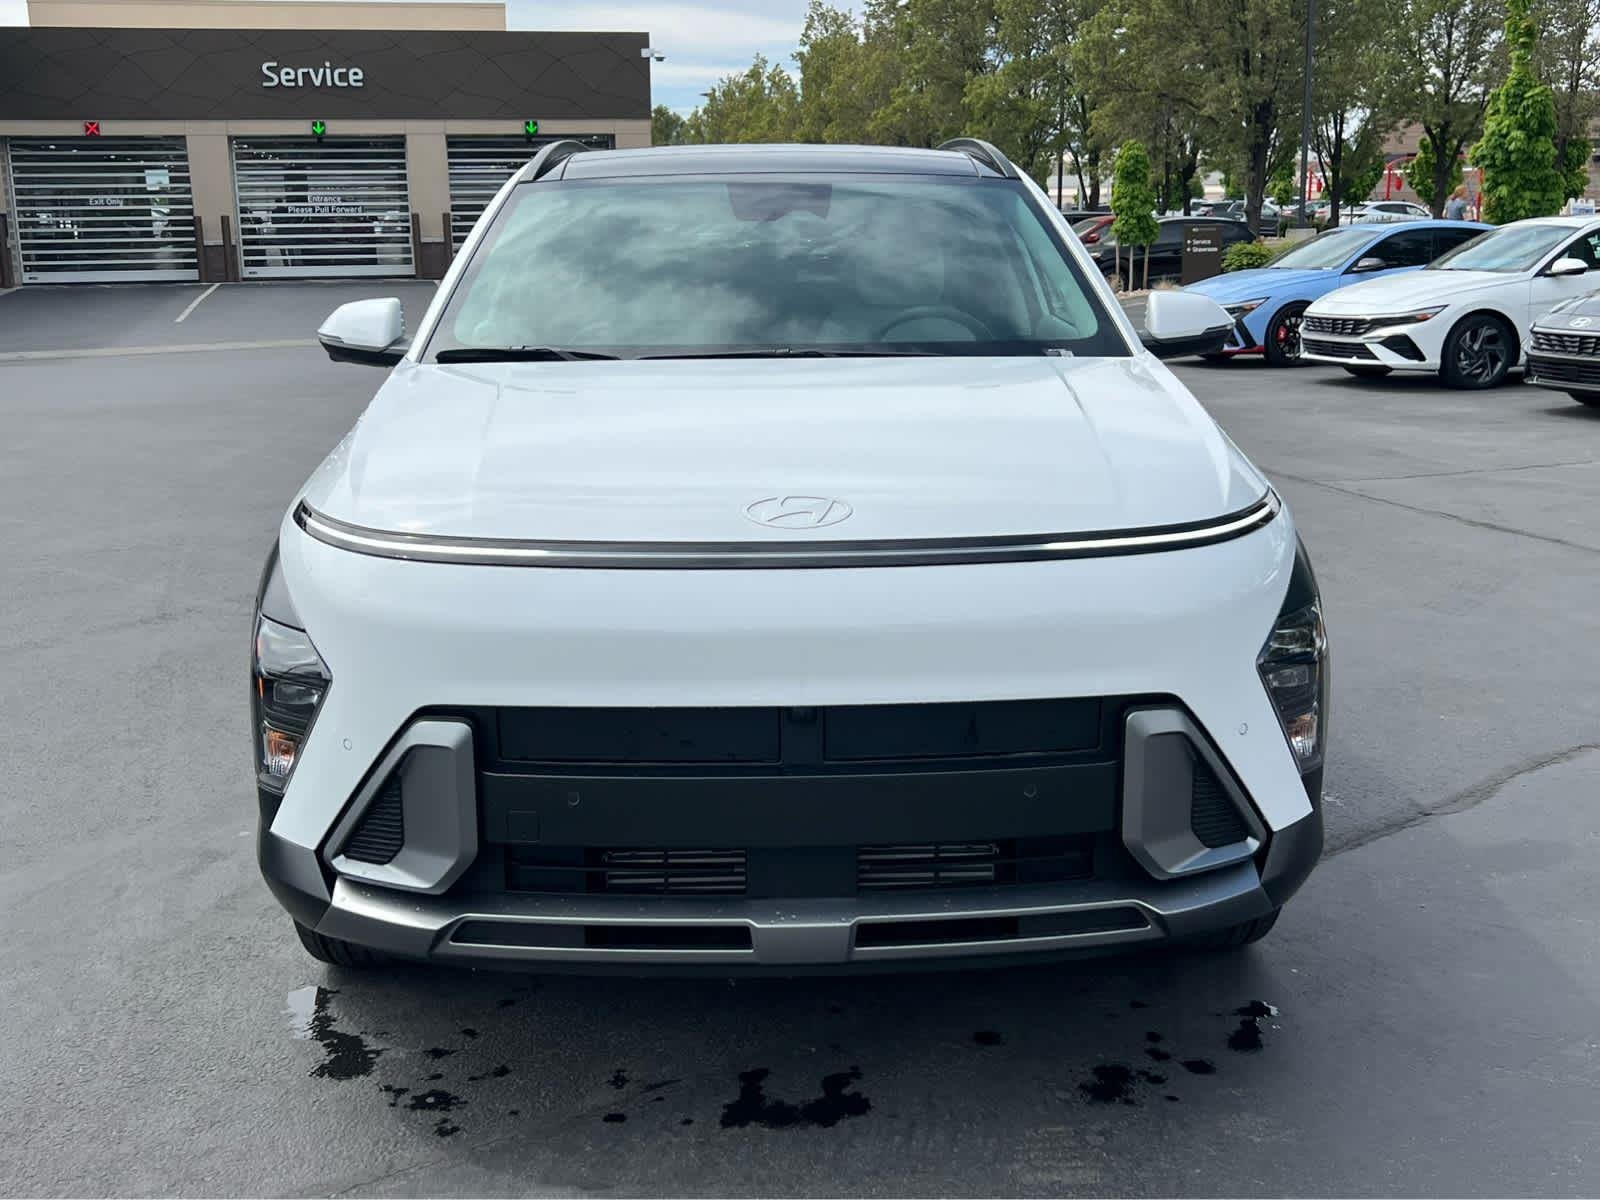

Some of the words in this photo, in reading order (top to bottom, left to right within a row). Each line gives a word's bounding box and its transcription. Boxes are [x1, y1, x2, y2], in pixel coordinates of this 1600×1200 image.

[261, 61, 364, 87] Service
[88, 197, 105, 206] Exit
[106, 197, 124, 207] Only
[307, 192, 342, 203] Entrance
[287, 205, 312, 214] Please
[314, 205, 330, 214] Pull
[331, 205, 362, 214] Forward
